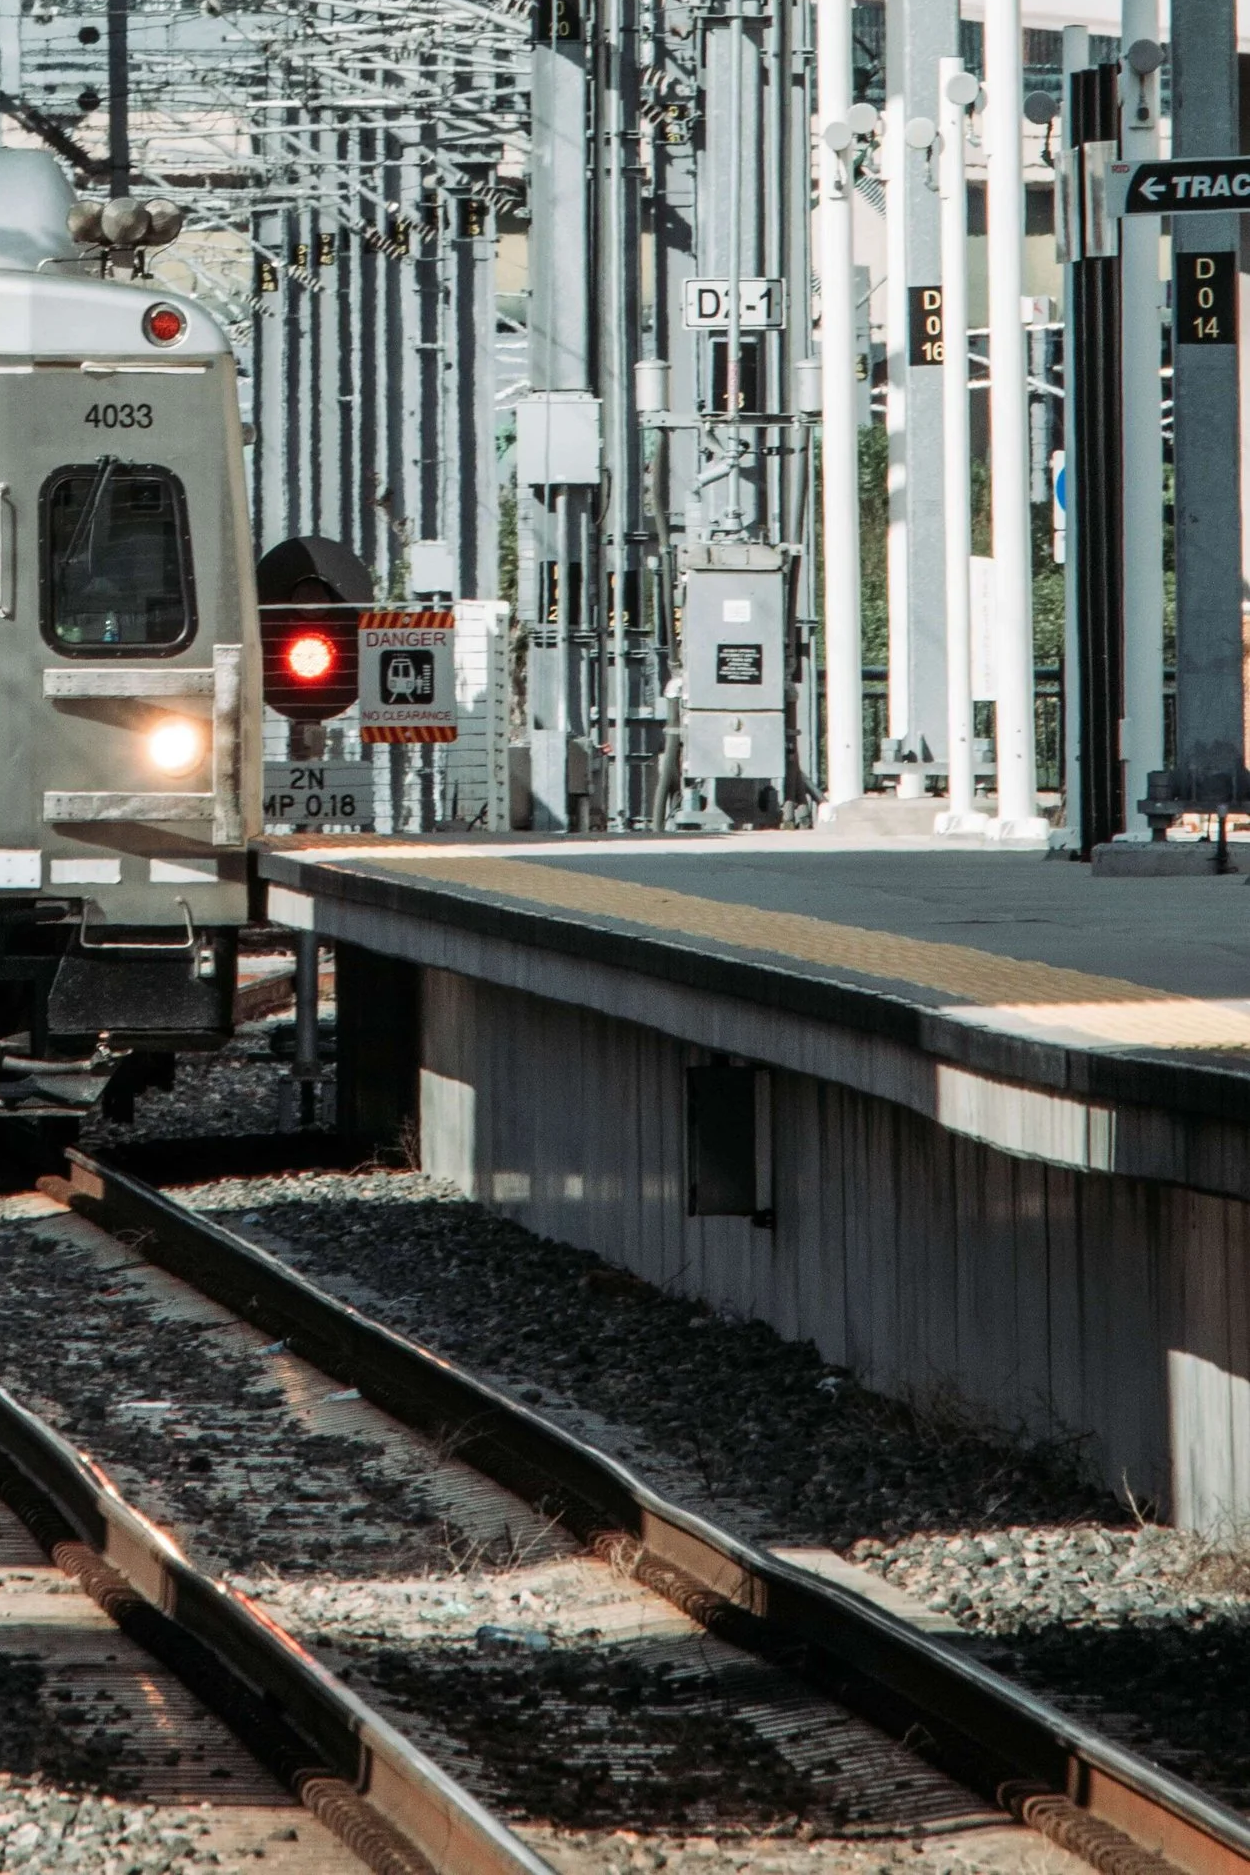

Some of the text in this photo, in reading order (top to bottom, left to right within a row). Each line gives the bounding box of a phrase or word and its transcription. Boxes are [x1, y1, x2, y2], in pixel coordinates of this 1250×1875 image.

[1196, 258, 1215, 279] D
[923, 290, 942, 310] D
[1199, 287, 1214, 309] 0
[926, 315, 941, 335] 0
[1193, 316, 1220, 338] 14
[921, 341, 944, 361] 16
[84, 403, 153, 429] 4033
[366, 632, 447, 647] DANGER
[362, 711, 452, 721] NO CLEARANCE
[290, 768, 325, 790] 2N
[305, 795, 356, 817] 0.18
